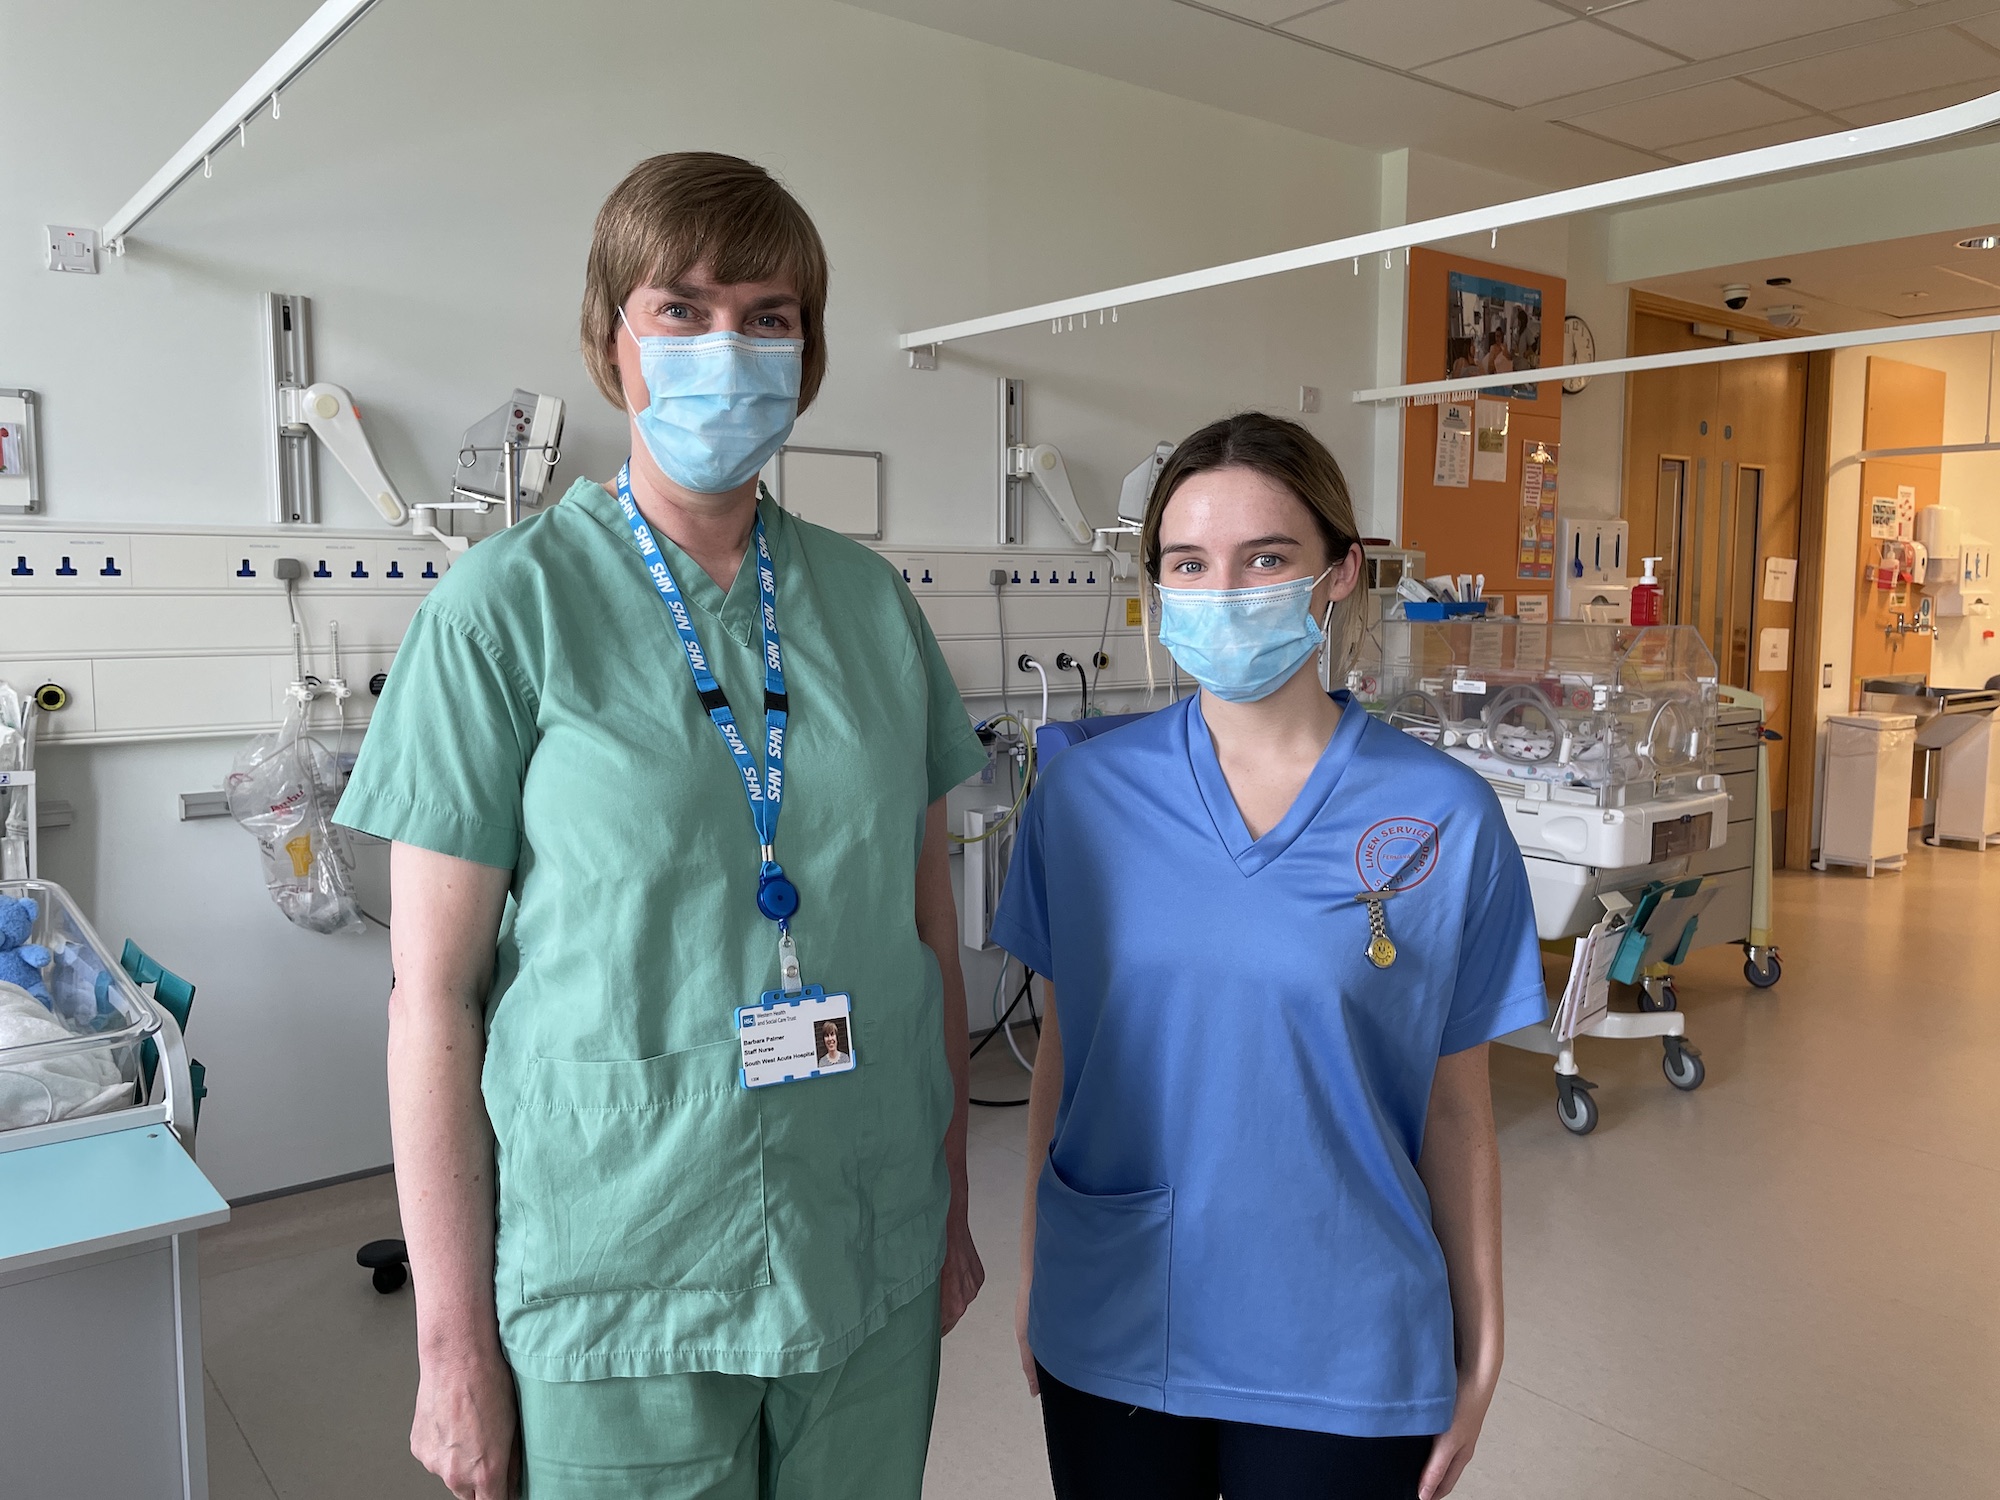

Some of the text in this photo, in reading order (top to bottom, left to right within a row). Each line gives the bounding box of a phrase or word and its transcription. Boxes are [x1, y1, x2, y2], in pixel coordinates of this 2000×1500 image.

[618, 492, 636, 521] NHS
[634, 524, 657, 557] NHS
[649, 562, 676, 593] NHS
[668, 601, 691, 630] NHS
[685, 639, 707, 671] NHS
[759, 567, 775, 596] NHS
[764, 602, 777, 634] NHS
[767, 640, 781, 673] NHS
[721, 723, 764, 801] NHS NHS
[767, 726, 783, 803] NHS NHS
[1365, 836, 1380, 868] LINEN
[743, 1038, 765, 1046] Barbara
[744, 1048, 758, 1056] Staff
[744, 1059, 761, 1067] South
[762, 1057, 776, 1065] West
[793, 1050, 815, 1060] Hospital
